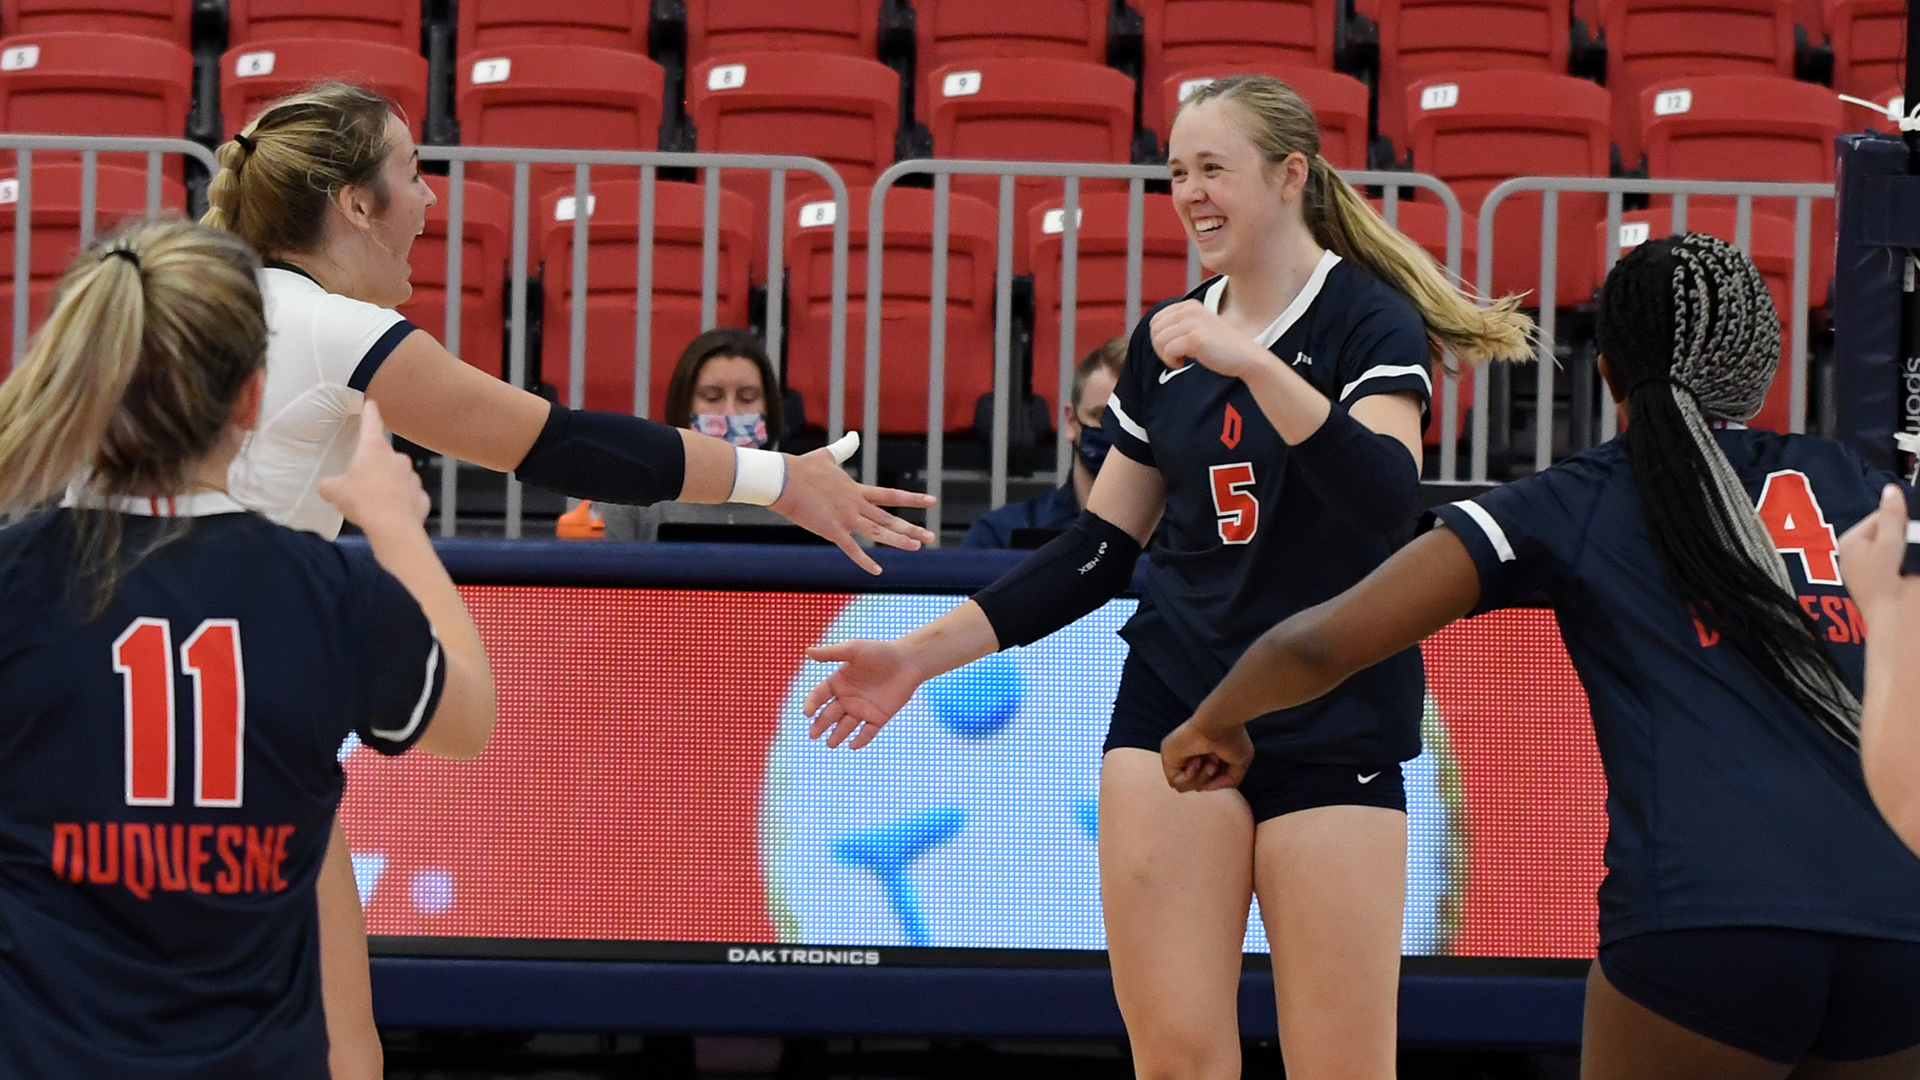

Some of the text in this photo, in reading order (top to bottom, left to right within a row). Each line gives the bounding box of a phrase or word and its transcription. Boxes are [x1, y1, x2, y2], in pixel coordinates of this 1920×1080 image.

[17, 52, 24, 65] 5
[252, 59, 260, 71] 6
[489, 65, 496, 79] 7
[724, 71, 732, 84] 8
[959, 77, 967, 91] 9
[1433, 90, 1448, 104] 11
[1667, 96, 1682, 109] 12
[3, 186, 12, 199] 5
[815, 207, 825, 221] 8
[1209, 462, 1259, 545] 5
[1755, 469, 1843, 586] 4
[112, 616, 245, 808] 11
[52, 822, 296, 900] DUQUESNE
[728, 948, 881, 966] DAKTRONICS
